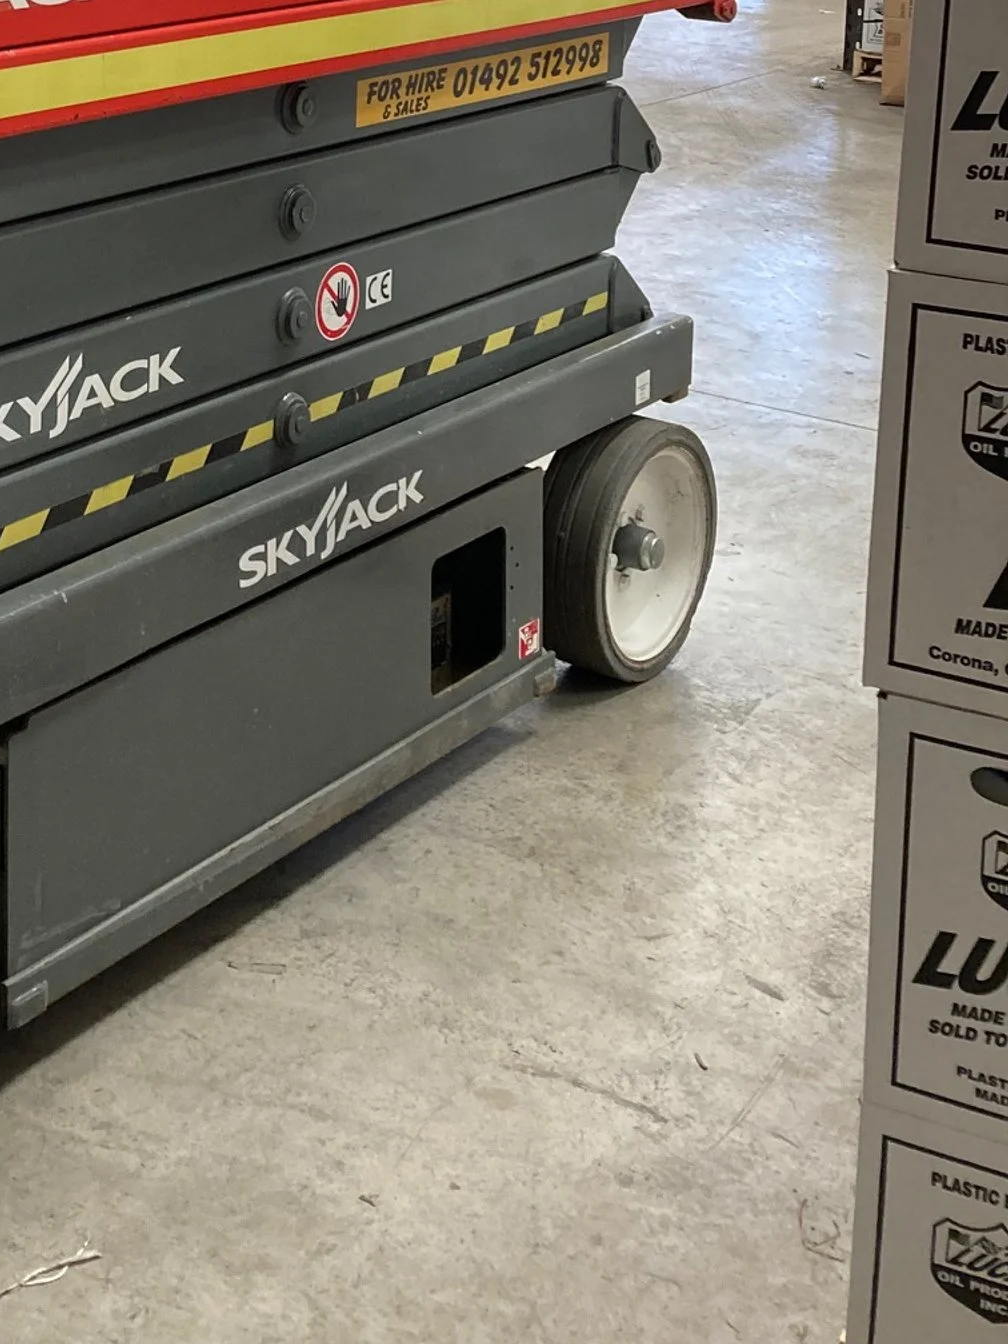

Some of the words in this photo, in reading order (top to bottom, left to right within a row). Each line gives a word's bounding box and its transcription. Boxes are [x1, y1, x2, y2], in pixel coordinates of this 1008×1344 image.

[366, 76, 401, 105] FOR
[405, 67, 447, 97] HIRE
[452, 56, 522, 99] 01492
[527, 39, 603, 82] 512998
[382, 104, 392, 120] &
[394, 95, 430, 116] SALES
[962, 333, 1008, 355] PLAS
[969, 441, 998, 456] OIL
[239, 469, 424, 588] SKYJACK
[928, 645, 999, 677] Corona,
[950, 1002, 1007, 1025] MADE
[928, 1019, 978, 1042] SOLD
[984, 1030, 1008, 1048] TO
[956, 1065, 1008, 1090] PLAST
[975, 1087, 1008, 1106] MAD
[931, 1171, 1000, 1206] PLASTIC
[946, 1247, 1008, 1279] LUC
[937, 1270, 965, 1288] OIL
